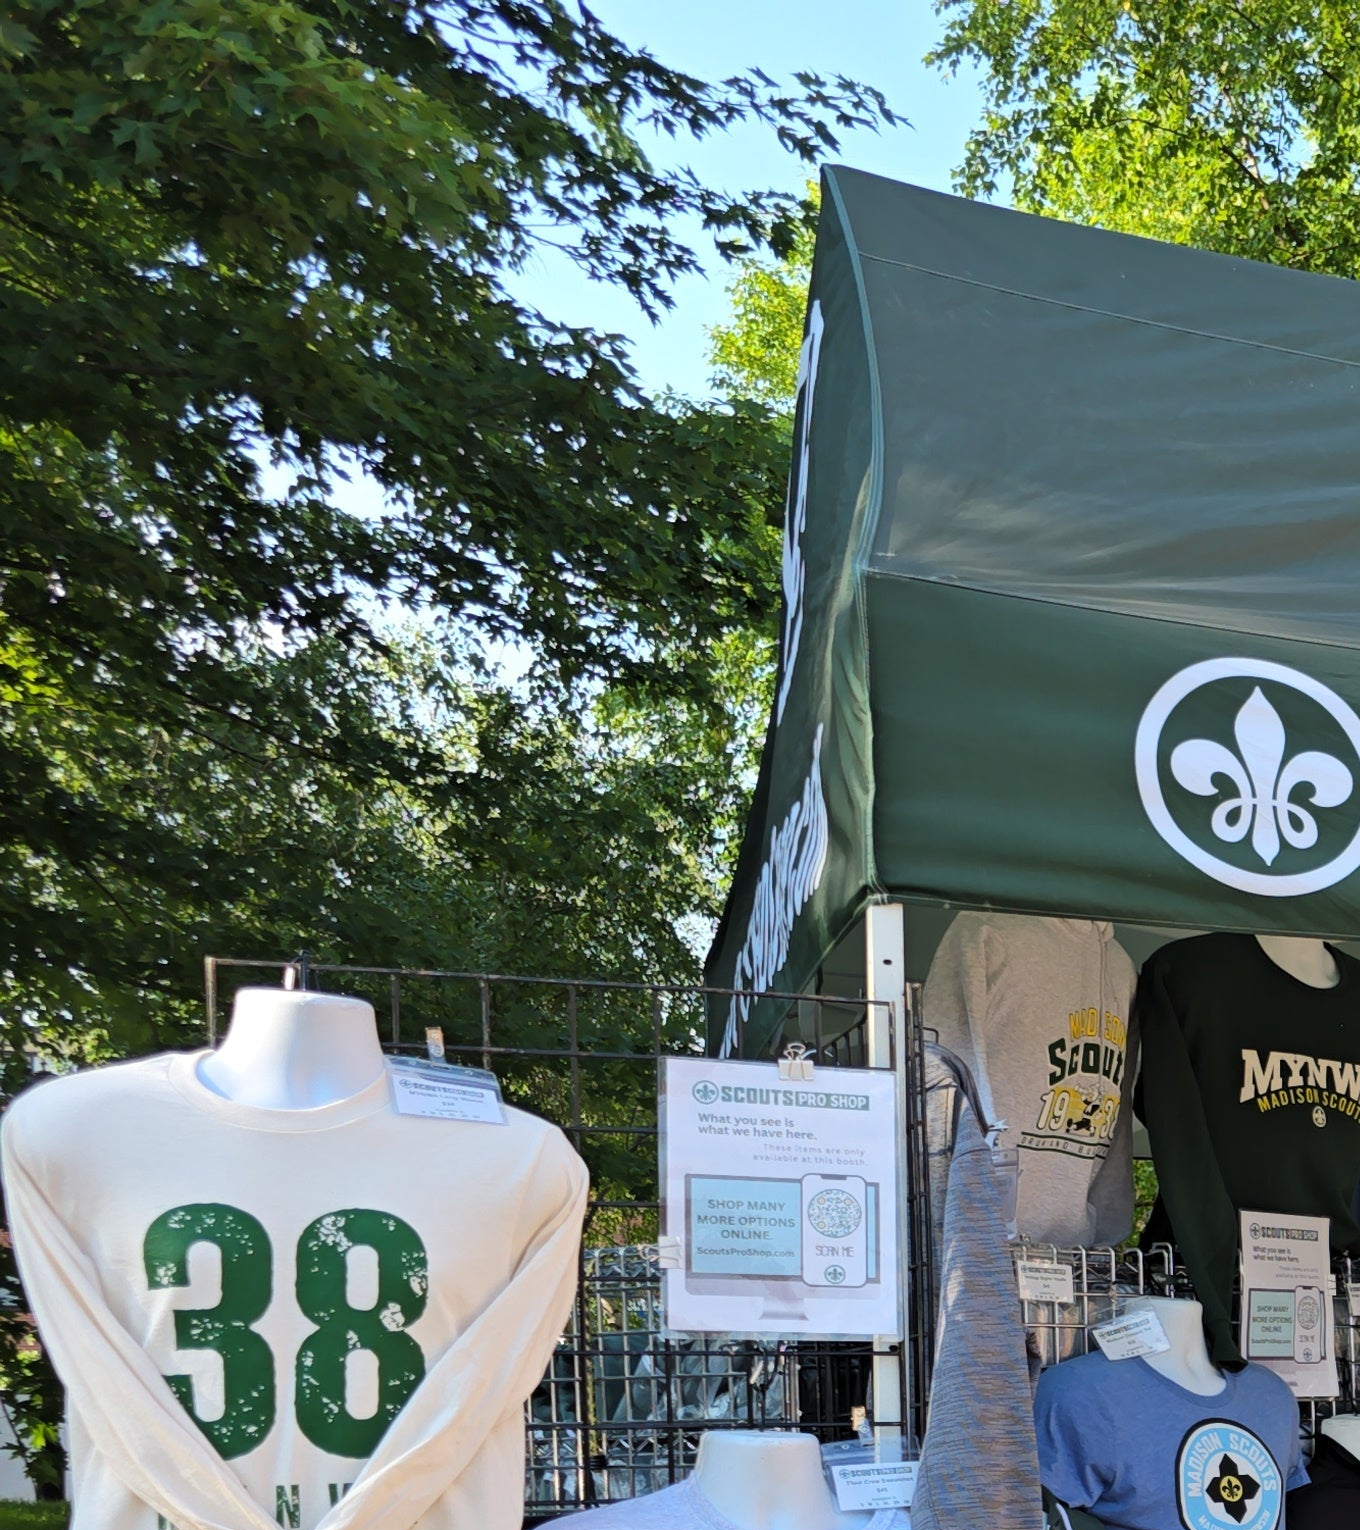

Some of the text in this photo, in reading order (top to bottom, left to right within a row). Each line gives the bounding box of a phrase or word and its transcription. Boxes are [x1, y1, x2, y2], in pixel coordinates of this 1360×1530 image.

[721, 1086, 867, 1110] SCOUTS PRO SHOP
[1257, 1088, 1320, 1112] MADISON
[1036, 1089, 1070, 1131] 19
[698, 1113, 794, 1128] What you see is
[698, 1125, 817, 1140] what we have here.
[707, 1200, 786, 1212] SHOP MANY
[697, 1215, 796, 1228] MORE OPTIONS
[1261, 1226, 1290, 1240] SCOUTS
[697, 1246, 795, 1258] ScoutsProShop.com
[1257, 1305, 1272, 1313] SHOP
[1269, 1316, 1293, 1324] OPTIONS
[143, 1203, 428, 1461] 38
[1188, 1432, 1277, 1497] MADISON SCOUTS
